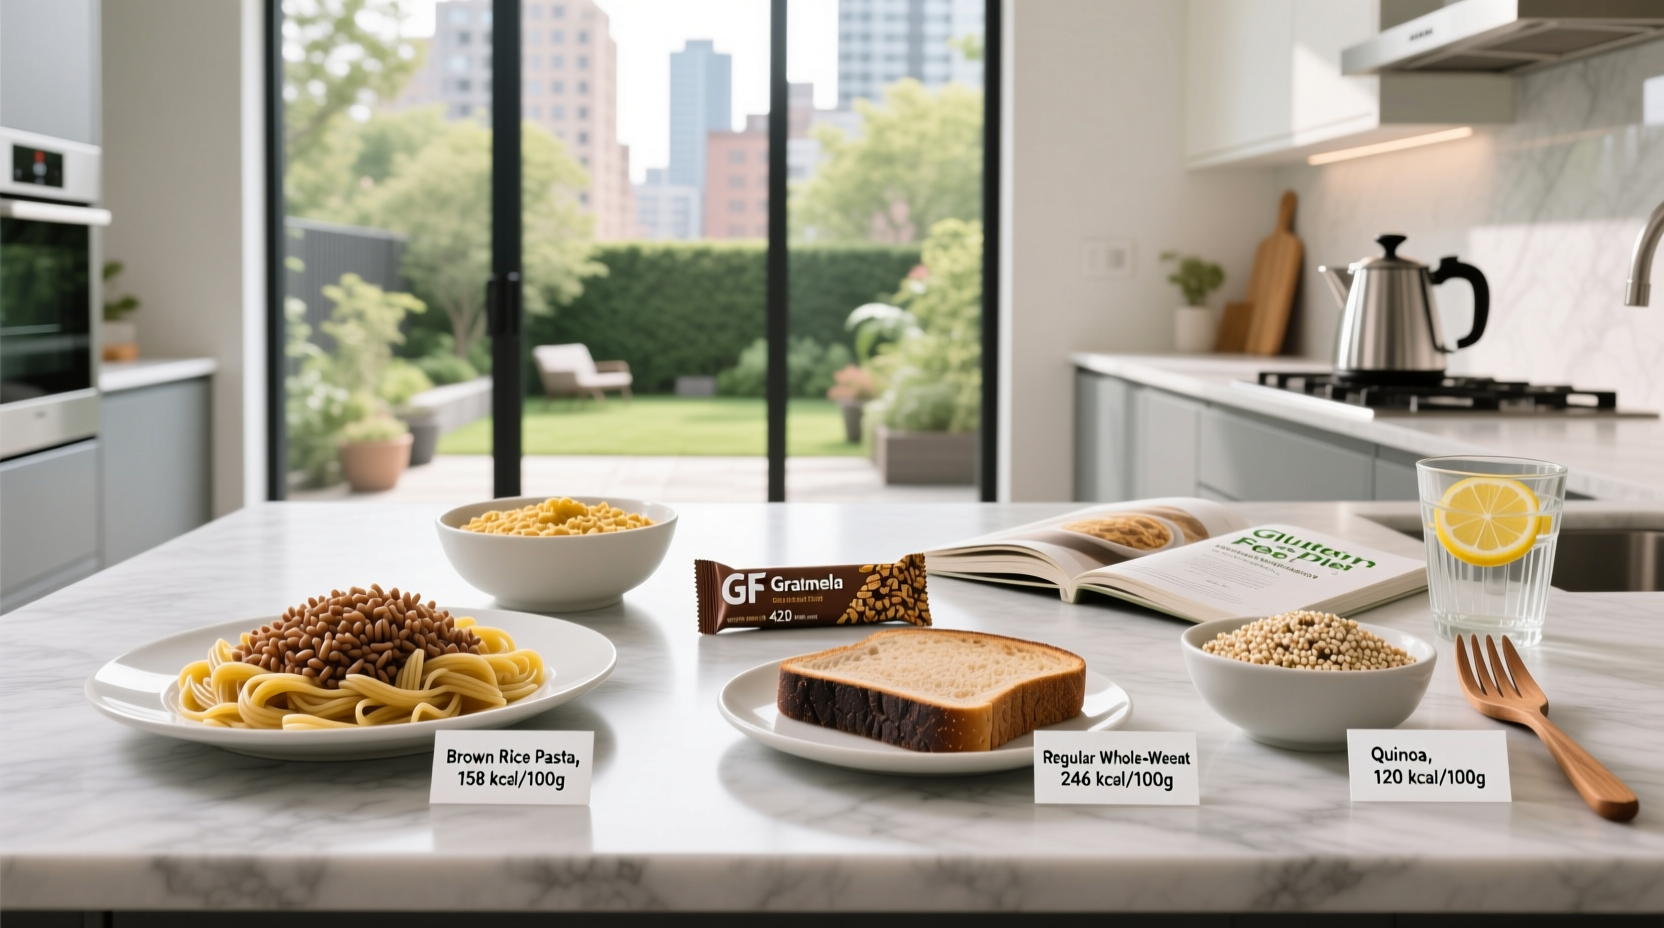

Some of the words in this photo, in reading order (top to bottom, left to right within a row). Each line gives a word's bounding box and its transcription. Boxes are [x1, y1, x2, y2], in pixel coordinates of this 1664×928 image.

[721, 572, 767, 605] GF
[769, 610, 792, 622] 420
[447, 749, 494, 764] Brown
[500, 749, 530, 764] Rice
[535, 749, 580, 768] Pasta,
[1043, 750, 1096, 768] Regular
[1371, 746, 1432, 765] Quinoa,
[458, 771, 485, 786] 158
[490, 770, 565, 791] kcal/100g
[1061, 771, 1091, 786] 246
[1096, 771, 1174, 792] kcal/100g
[1374, 769, 1403, 785] 120
[1408, 768, 1486, 789] kcal/100g
